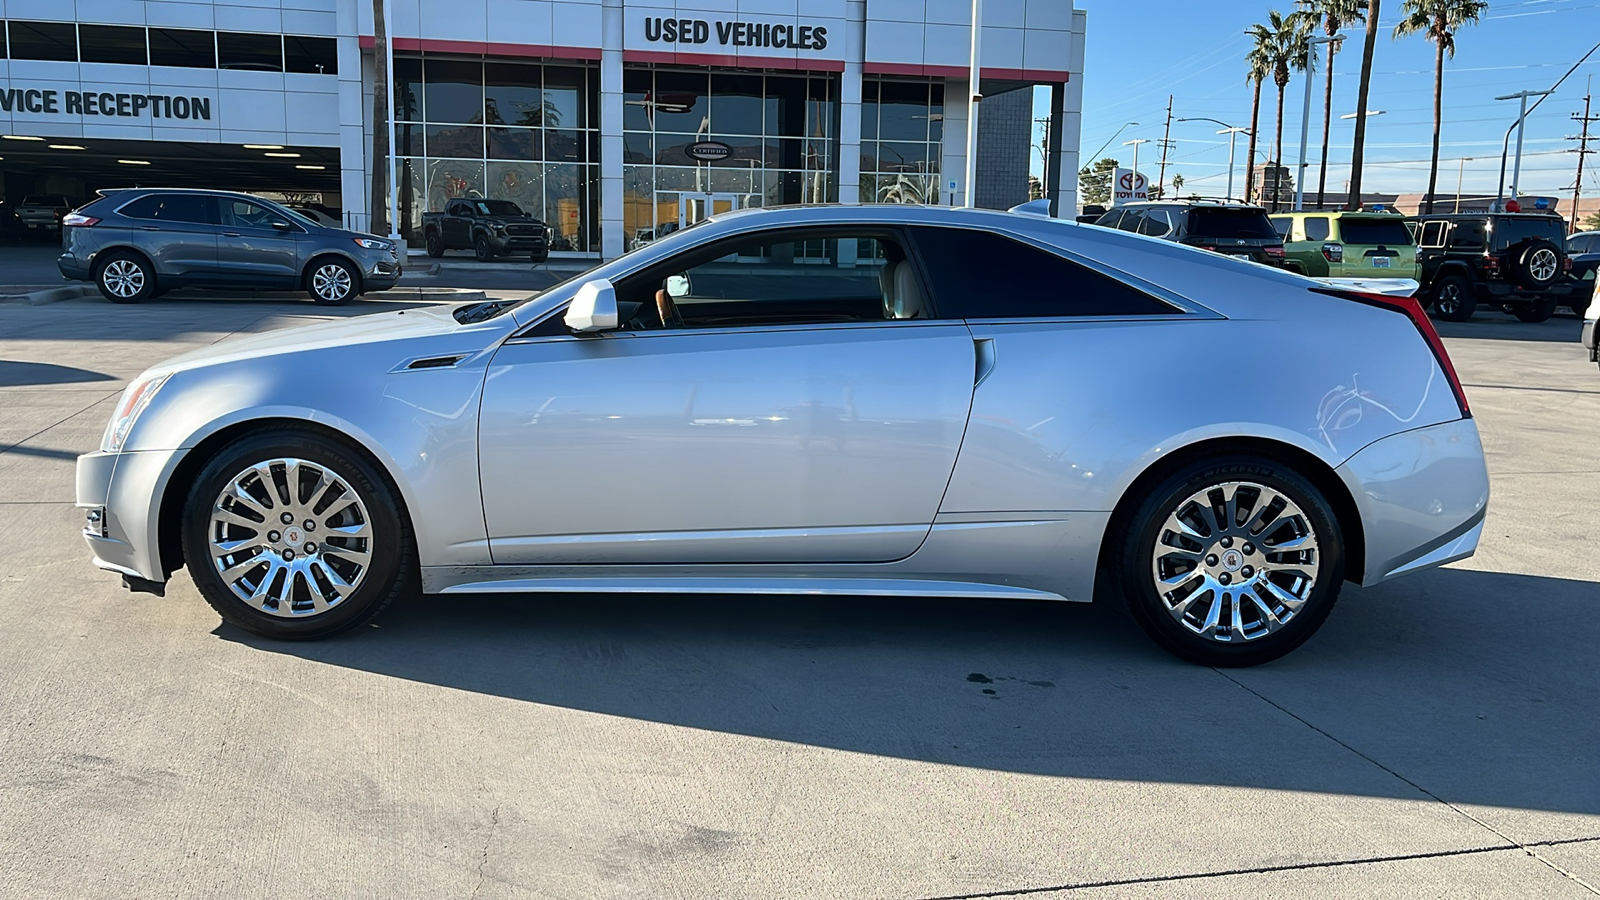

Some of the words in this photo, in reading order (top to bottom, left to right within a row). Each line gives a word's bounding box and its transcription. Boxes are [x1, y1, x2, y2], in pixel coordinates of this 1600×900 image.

[645, 17, 709, 43] USED
[715, 21, 827, 50] VEHICLES
[0, 88, 58, 113] VICE
[65, 91, 210, 119] RECEPTION
[323, 451, 373, 492] MICHELIN
[1205, 465, 1271, 476] MICHELIN
